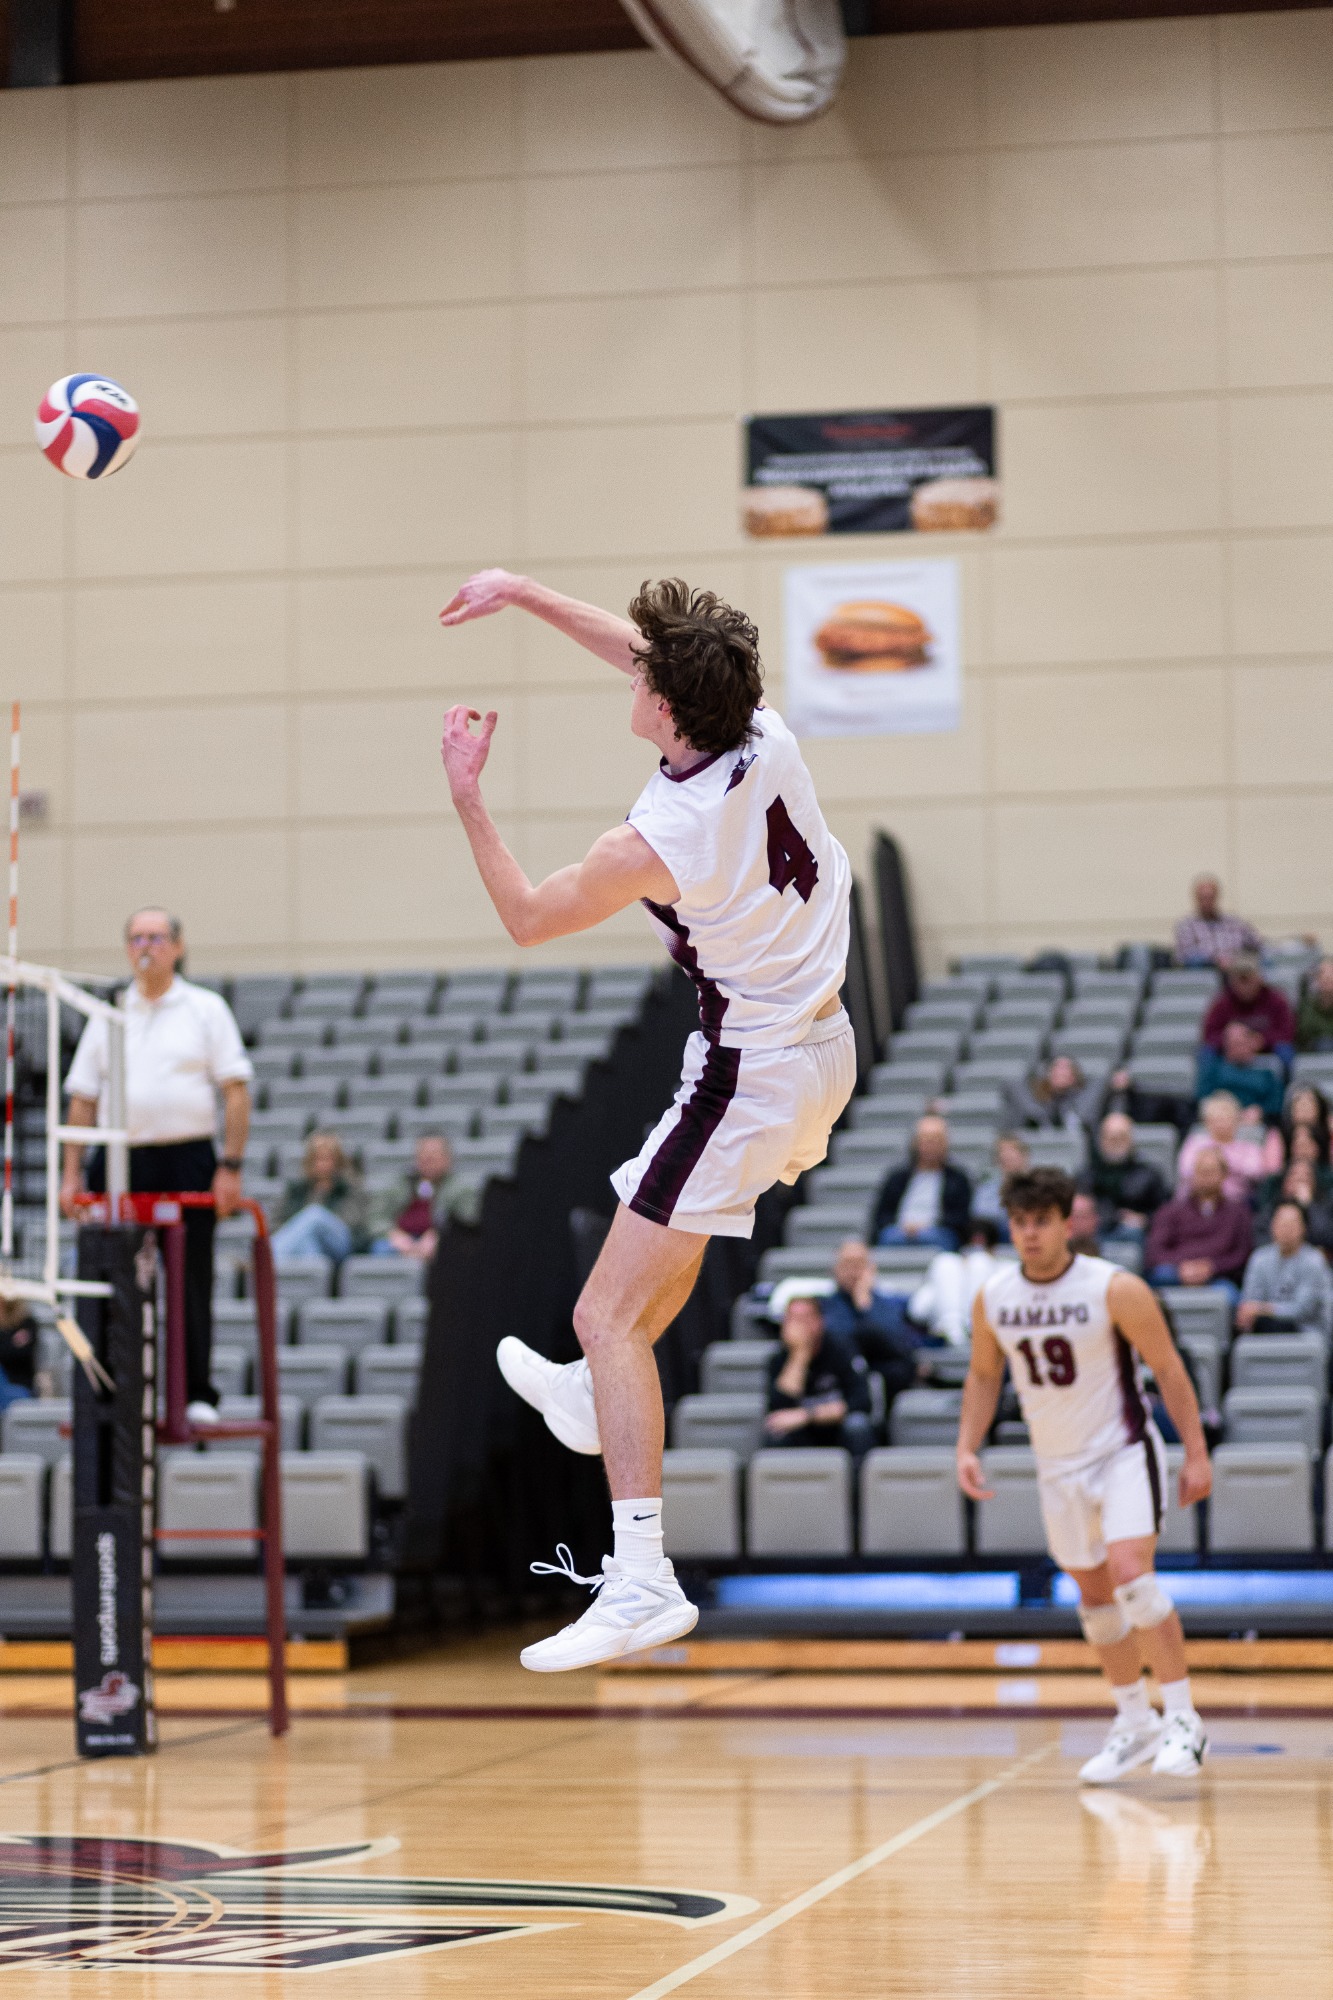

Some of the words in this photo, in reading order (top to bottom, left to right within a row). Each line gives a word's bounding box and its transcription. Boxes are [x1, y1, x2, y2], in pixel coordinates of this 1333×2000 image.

[766, 794, 818, 904] 4
[999, 1303, 1089, 1326] RAMAPO
[1017, 1335, 1076, 1387] 19
